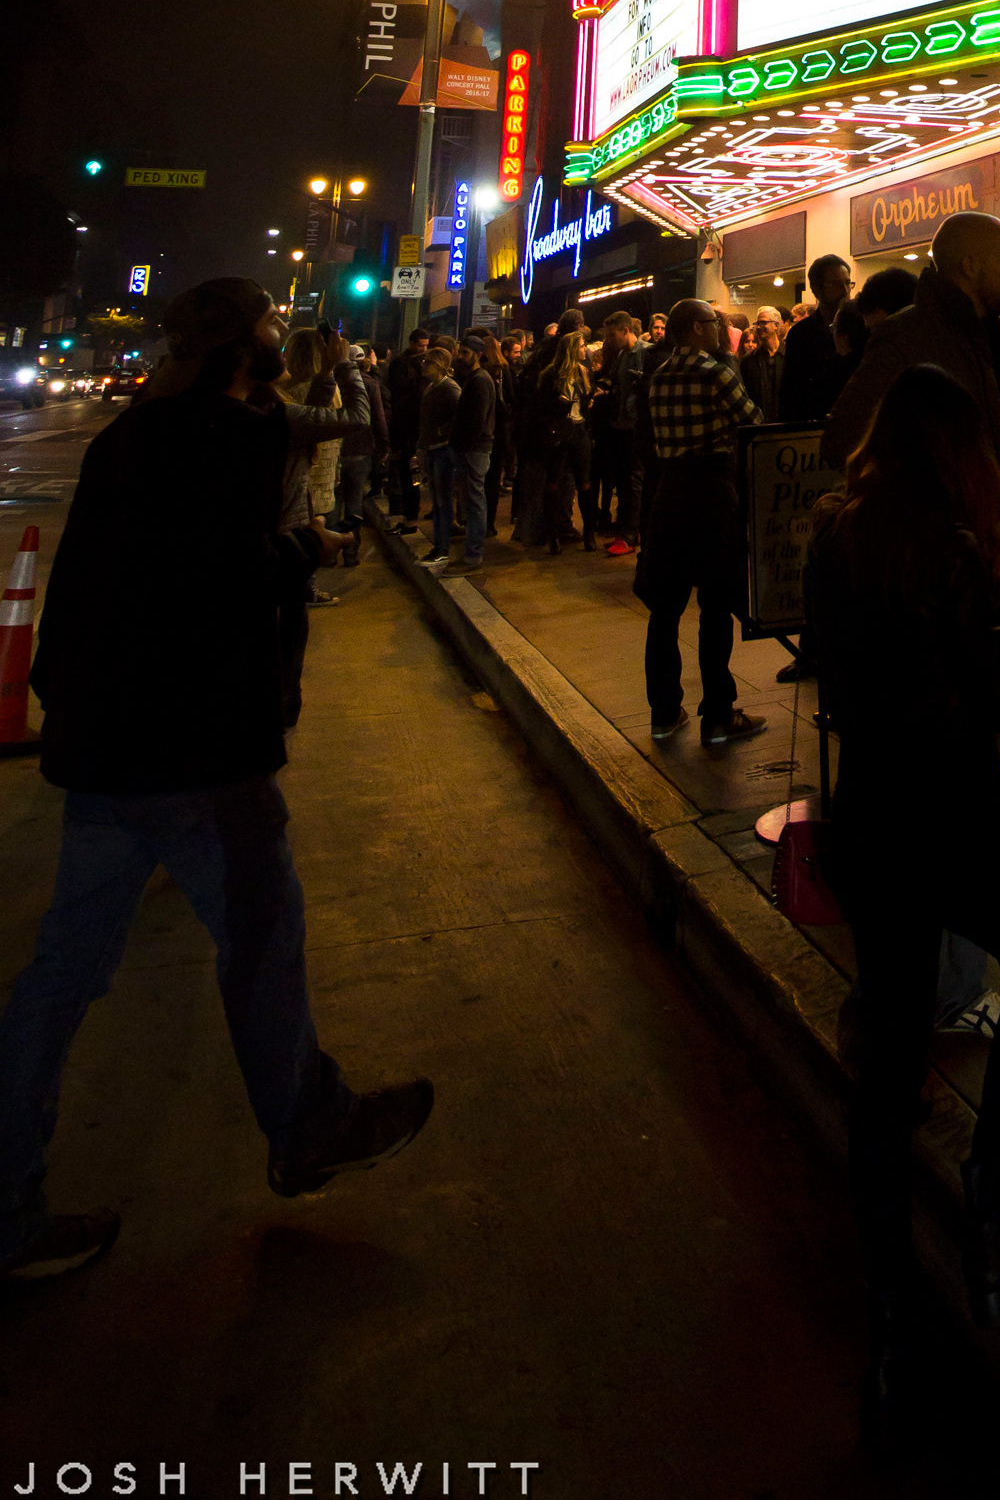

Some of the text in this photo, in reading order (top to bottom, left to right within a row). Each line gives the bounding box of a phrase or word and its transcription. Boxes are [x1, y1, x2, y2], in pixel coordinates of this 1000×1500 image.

[365, 2, 398, 70] PHIL
[630, 35, 652, 68] GO TO
[637, 12, 652, 40] INFO
[503, 54, 527, 197] PARKING
[133, 172, 199, 184] PED XING
[451, 182, 468, 284] AUTO PARK
[585, 189, 611, 240] bar
[872, 183, 978, 242] Orpheum
